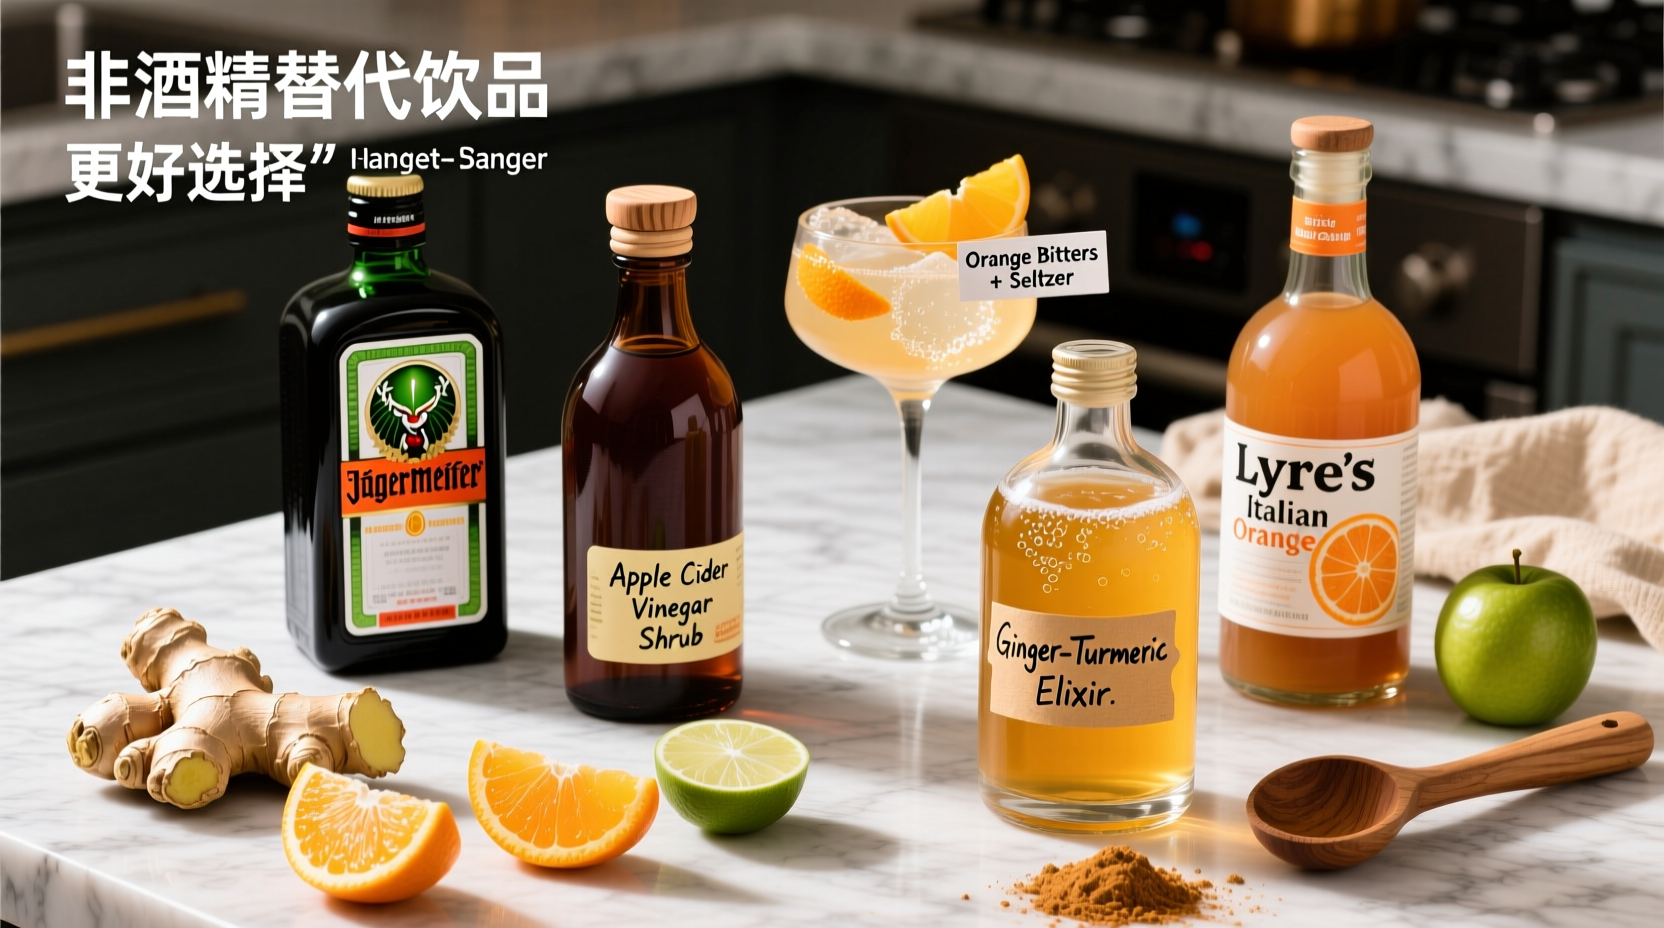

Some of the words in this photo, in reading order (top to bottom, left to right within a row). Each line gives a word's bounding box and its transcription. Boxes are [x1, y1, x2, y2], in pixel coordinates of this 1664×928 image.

[965, 251, 1032, 271] Orange
[1037, 246, 1098, 264] Bitters
[990, 275, 1002, 289] +
[1010, 269, 1075, 289] Seltzer
[1247, 494, 1328, 528] Italian
[1233, 517, 1317, 557] Orange
[609, 561, 672, 596] Apple
[681, 558, 729, 586] Cider
[632, 596, 713, 626] Vinegar
[638, 622, 703, 650] Shrub
[996, 621, 1168, 674] Ginger-Turmeric
[1036, 675, 1115, 707] Elixir.
